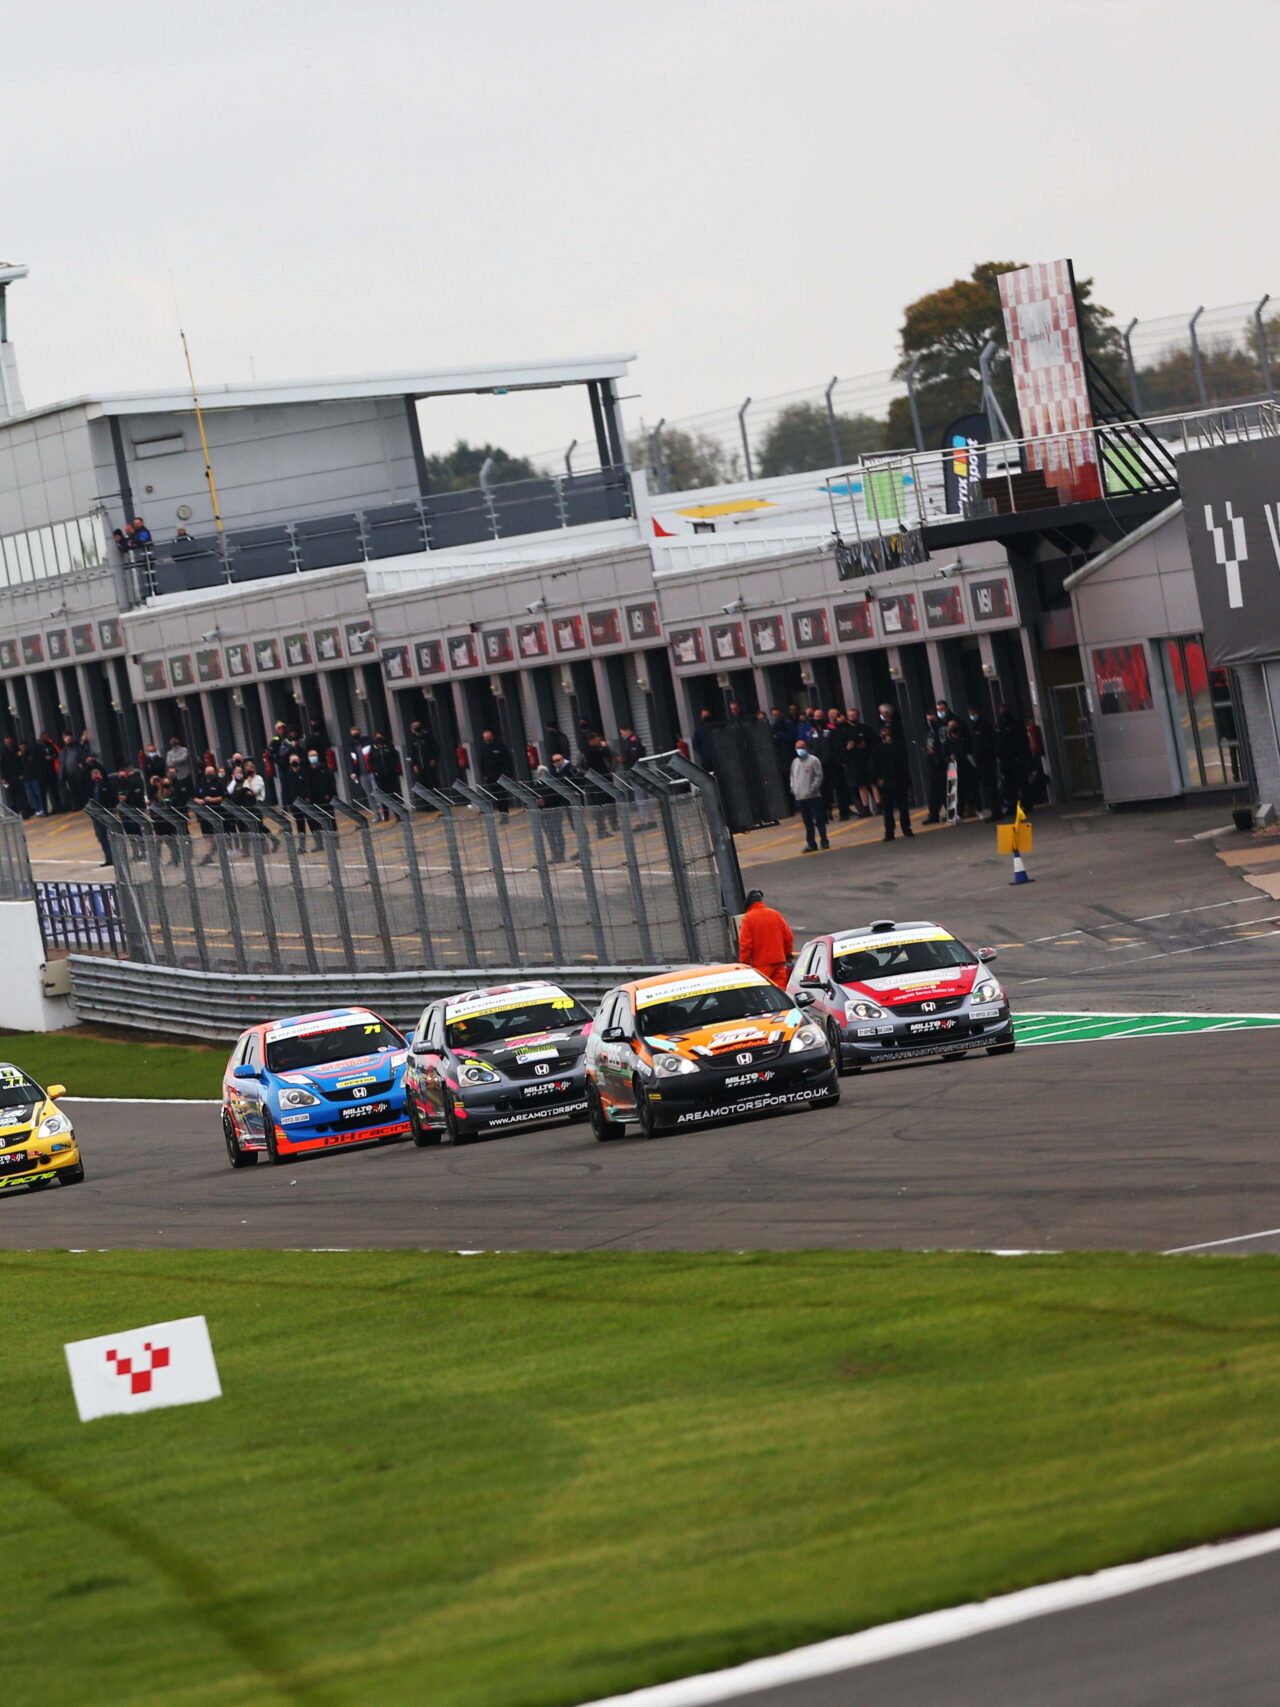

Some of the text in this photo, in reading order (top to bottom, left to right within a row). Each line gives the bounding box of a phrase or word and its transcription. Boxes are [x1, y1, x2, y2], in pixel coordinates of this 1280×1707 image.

[363, 1024, 381, 1035] 71
[5, 1077, 24, 1088] 77
[677, 1086, 830, 1124] AREAMOTORSPORT.CO.UK
